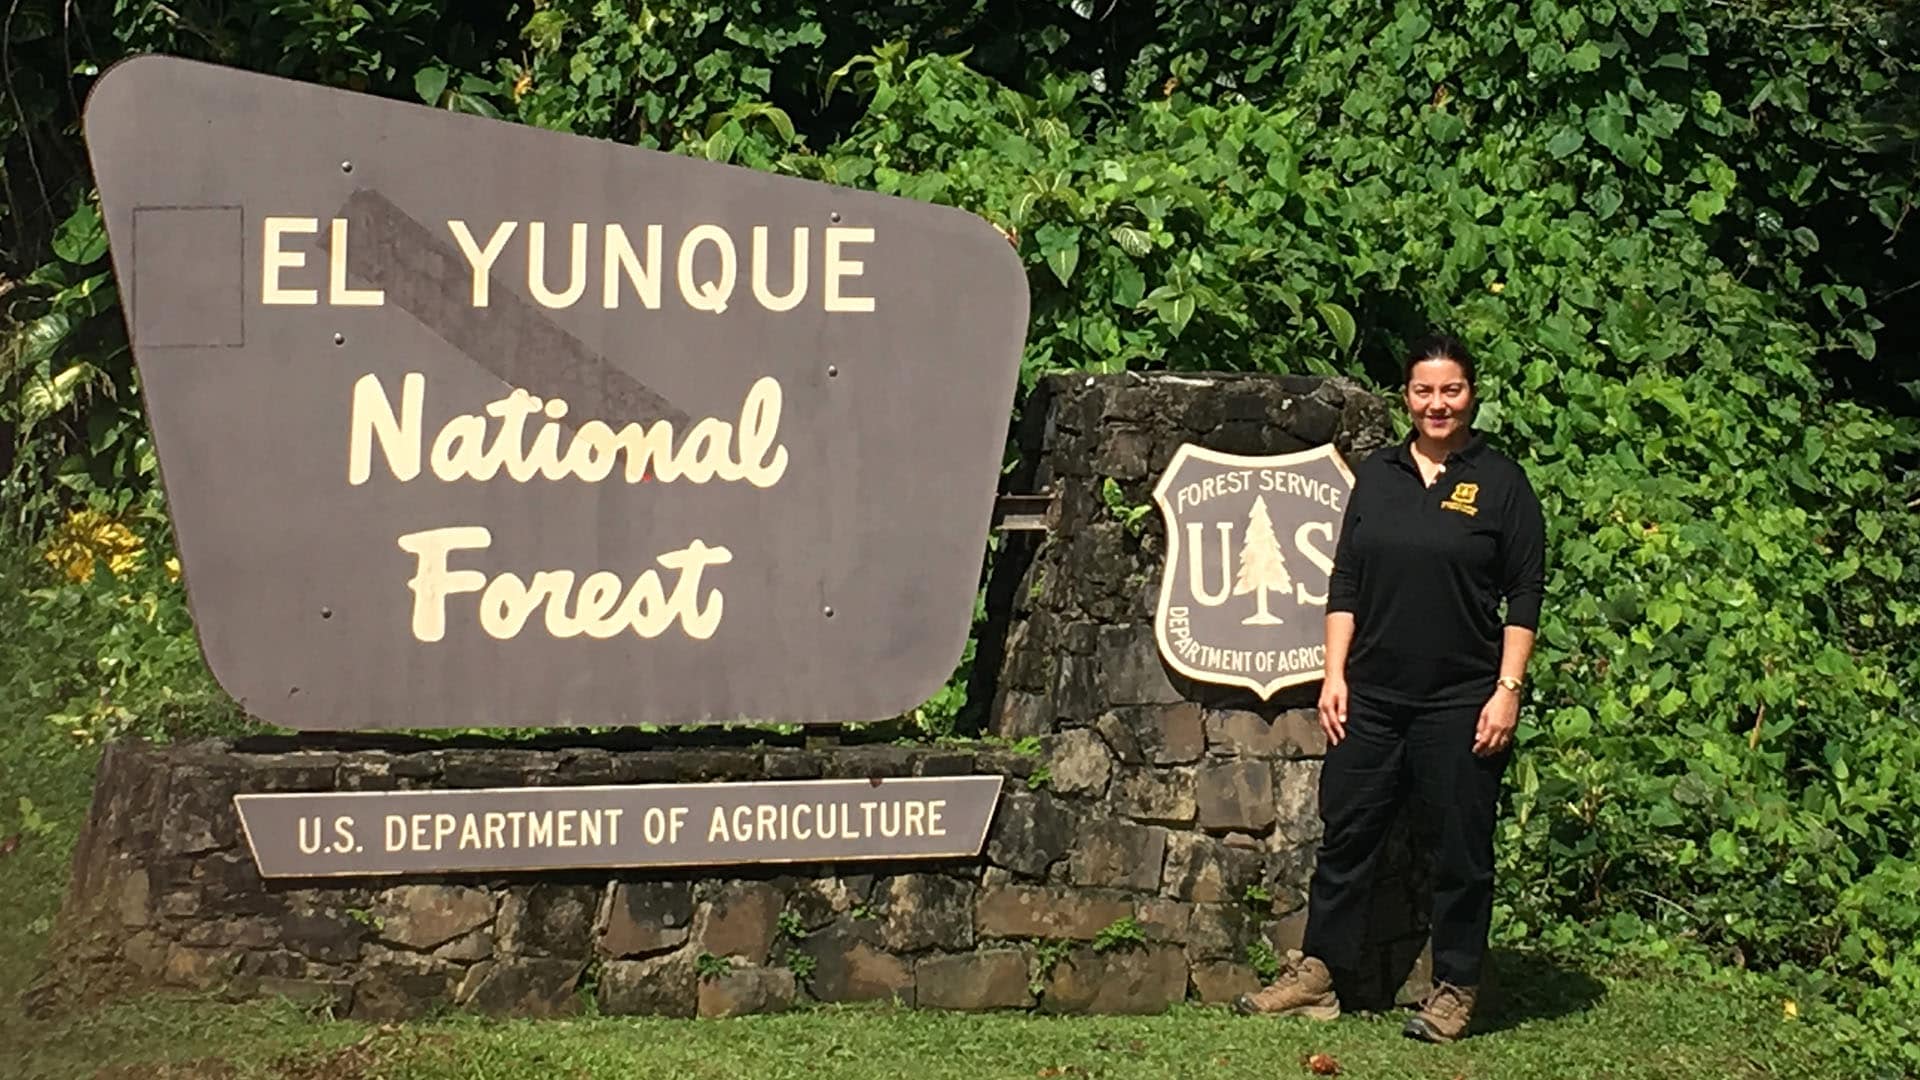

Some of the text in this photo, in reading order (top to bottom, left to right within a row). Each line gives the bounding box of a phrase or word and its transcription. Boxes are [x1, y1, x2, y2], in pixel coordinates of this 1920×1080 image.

[262, 217, 876, 315] EL YUNQUE
[348, 372, 789, 488] National
[1177, 469, 1342, 514] FOREST SERVICE
[397, 526, 733, 643] Forest
[1169, 606, 1326, 672] DEPARTMENT OF AGRIC
[298, 799, 947, 854] U.S. DEPARTMENT OF AGRICULTURE
